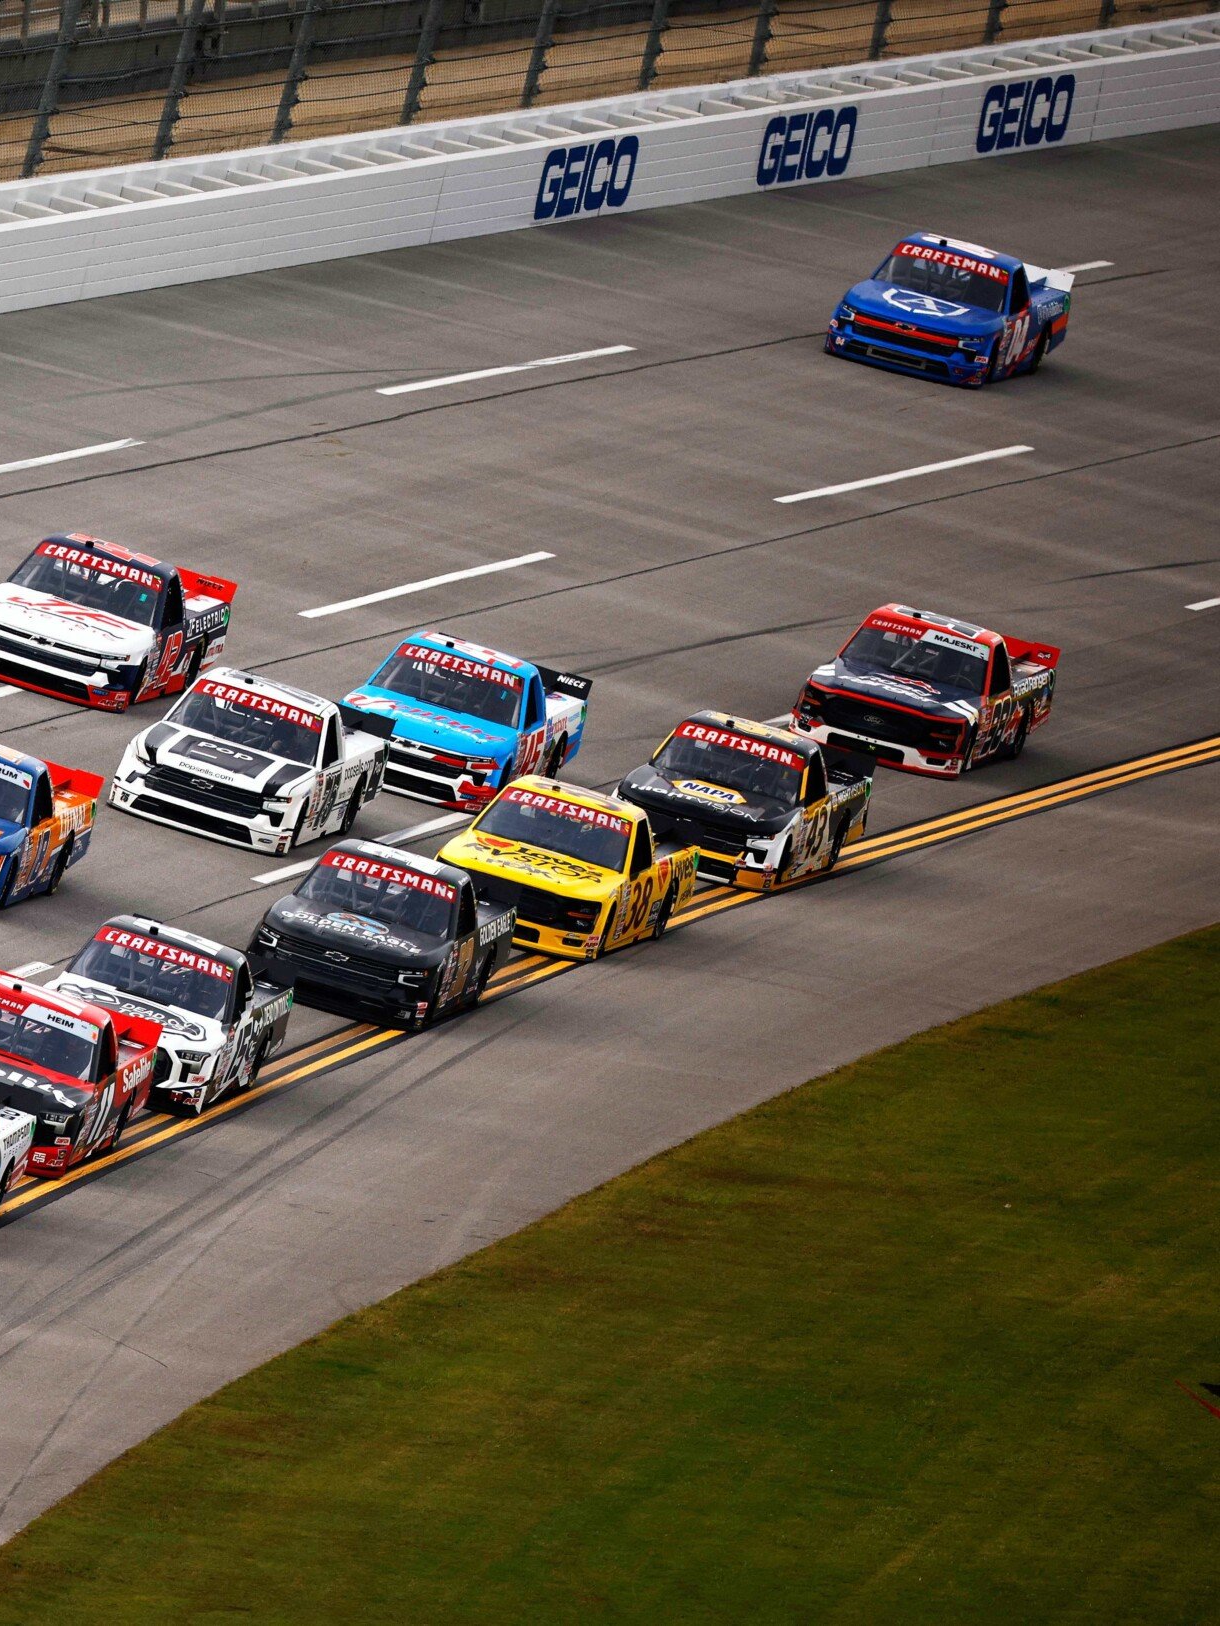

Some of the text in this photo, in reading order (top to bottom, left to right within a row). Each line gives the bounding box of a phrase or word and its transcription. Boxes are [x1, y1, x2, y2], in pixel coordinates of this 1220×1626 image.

[977, 74, 1075, 153] GEICO
[756, 106, 857, 186] GEICO
[534, 135, 639, 220] GEICO
[901, 244, 1000, 279] CRAFTSMAN
[44, 544, 154, 586] CRAFTSMAN
[196, 609, 225, 633] ELECTRIC
[871, 619, 979, 653] CRAFTSMAN MAJESKI
[405, 645, 515, 687] CRAFTSMAN
[557, 675, 586, 689] NIECE
[202, 683, 313, 727] CRAFTSMAN
[682, 725, 792, 766] CRAFTSMAN
[179, 760, 234, 782] popsells.com
[508, 790, 622, 831] CRAFTSMAN
[683, 781, 737, 803] NAPA
[331, 855, 448, 898] CRAFTSMAN
[281, 910, 357, 932] GOLDEN
[622, 877, 653, 934] 38
[105, 931, 223, 979] CRAFTSMAN
[47, 1014, 75, 1029] HEIM
[122, 1003, 165, 1019] DEAD
[122, 1056, 151, 1093] Safelite
